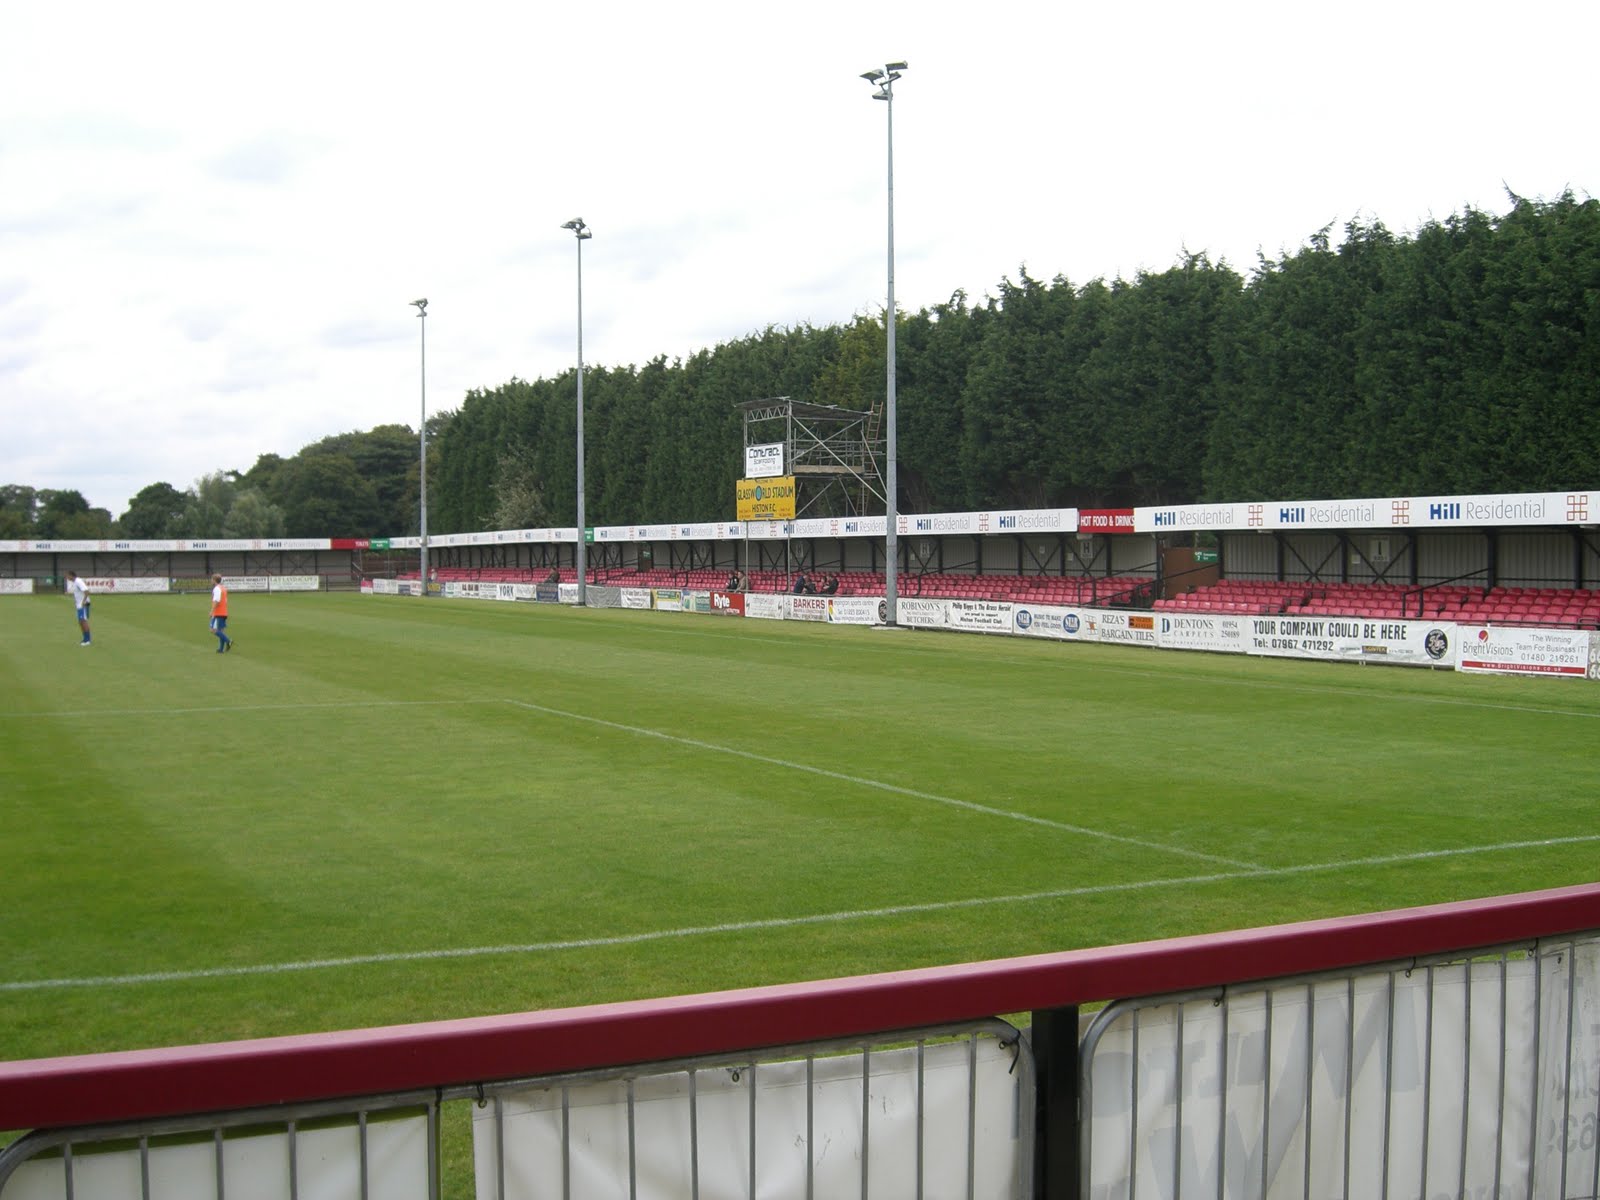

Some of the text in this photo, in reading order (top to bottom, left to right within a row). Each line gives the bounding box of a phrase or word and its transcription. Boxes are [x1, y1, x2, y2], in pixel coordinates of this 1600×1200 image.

[772, 486, 794, 498] STADIUM
[752, 504, 769, 513] HISTON
[1280, 504, 1375, 523] Hill Residential
[1430, 498, 1545, 520] Hill Residential
[1000, 513, 1061, 528] Hill Residential
[1080, 515, 1135, 526] HOT FOOD & DRINKS
[1154, 507, 1234, 525] Hill Residential
[845, 522, 858, 532] Hill
[917, 518, 970, 530] Hill Residential
[682, 528, 690, 536] Hill
[729, 526, 739, 535] Hill
[499, 585, 514, 597] YORK
[714, 593, 730, 607] Ryte
[793, 599, 826, 609] BARKERS
[901, 601, 940, 611] ROBINSON'S
[906, 616, 934, 624] BUTCHERS
[1102, 614, 1125, 624] REZA'S
[1174, 619, 1213, 629] DENTONS
[1101, 629, 1154, 641] BARGAIN TILES
[1173, 630, 1214, 638] CARPETS
[1253, 620, 1407, 640] YOUR COMPANY COULD BE HERE
[1253, 638, 1334, 650] Tel: 07967 471292
[1545, 635, 1571, 644] Winning
[1516, 643, 1532, 651] Team
[1547, 644, 1576, 652] Business
[1521, 652, 1579, 663] 01480 219261
